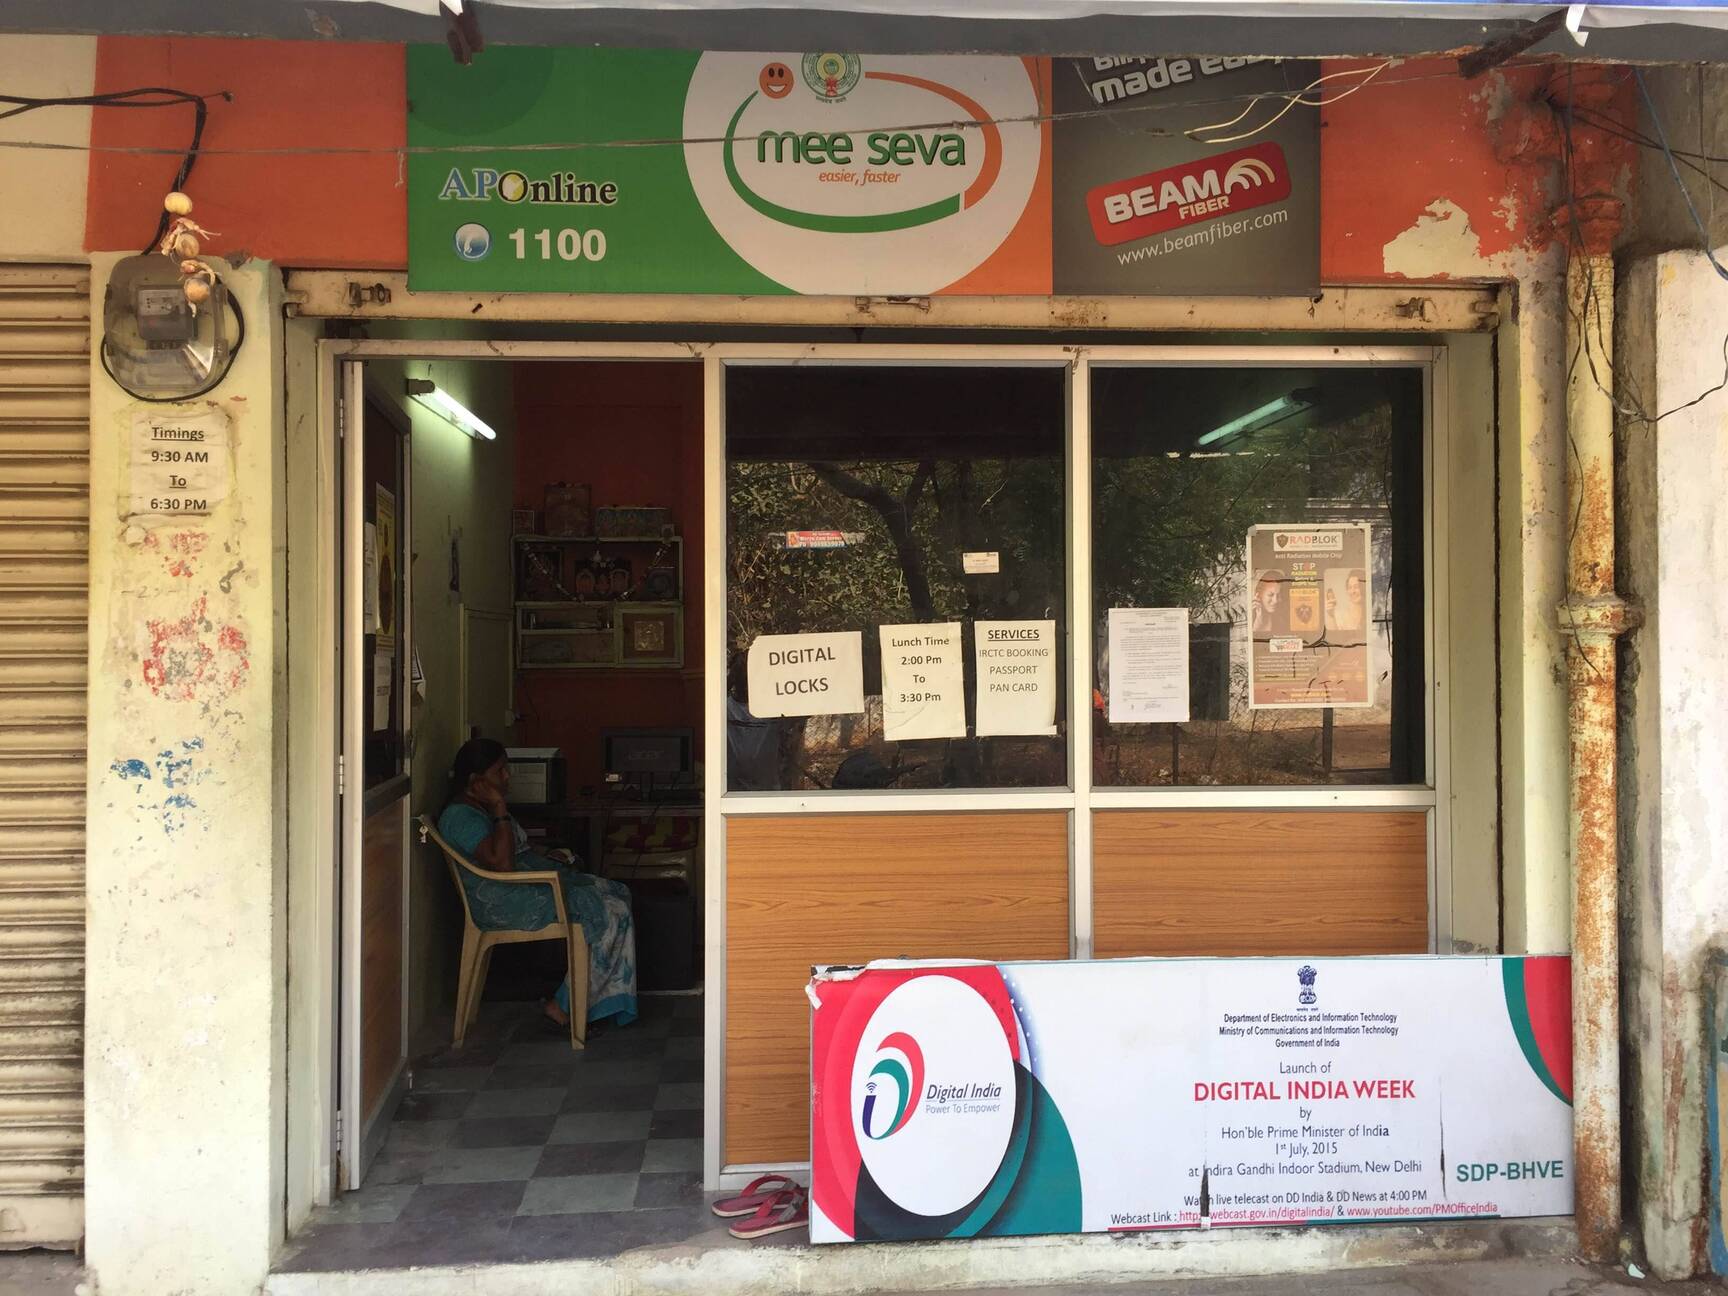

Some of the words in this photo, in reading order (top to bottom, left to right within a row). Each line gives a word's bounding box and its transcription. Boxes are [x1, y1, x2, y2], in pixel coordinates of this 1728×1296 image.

[1092, 57, 1193, 103] made
[757, 130, 853, 164] mee
[867, 132, 966, 166] seva
[819, 169, 860, 185] easier,
[860, 168, 901, 186] faster
[1103, 168, 1221, 224] BEAM
[1178, 195, 1230, 220] FIBER
[1117, 209, 1289, 265] www.beamfiber.com
[508, 228, 607, 261] 1100
[151, 427, 205, 441] Timings
[151, 450, 181, 462] 9:30
[184, 451, 209, 463] AM
[169, 475, 187, 488] To
[150, 498, 180, 510] 6:30
[184, 499, 207, 510] PM
[1289, 535, 1338, 544] RADBLOK
[892, 637, 922, 647] Lunch
[924, 636, 950, 646] Time
[988, 629, 1040, 641] SERVICES
[768, 646, 836, 666] DIGITAL
[979, 649, 1005, 657] IRCTC
[1006, 648, 1049, 657] BOOKING
[901, 656, 923, 665] 2:00
[926, 656, 942, 664] Pm
[989, 665, 1038, 675] PASSPORT
[913, 674, 926, 683] To
[775, 677, 829, 695] LOCKS
[990, 684, 1010, 692] PAN
[1012, 683, 1038, 692] CARD
[900, 693, 922, 702] 3:30
[925, 692, 941, 701] Pm
[1224, 1014, 1262, 1023] Department
[1263, 1014, 1270, 1022] of
[1271, 1013, 1307, 1022] Electronics
[1308, 1013, 1320, 1022] and
[1322, 1013, 1359, 1022] Information
[1360, 1013, 1398, 1023] Technology
[1219, 1026, 1245, 1036] Ministry
[1247, 1026, 1254, 1035] of
[1255, 1026, 1309, 1035] Communications
[1310, 1026, 1322, 1035] and
[1324, 1025, 1360, 1034] Information
[1362, 1025, 1399, 1036] Technology
[1275, 1039, 1315, 1048] Government
[1316, 1039, 1323, 1047] of
[1324, 1039, 1340, 1047] India
[1280, 1062, 1316, 1074] Launch
[1321, 1061, 1332, 1073] of
[926, 1083, 968, 1104] Digital
[970, 1082, 1001, 1098] India
[1194, 1081, 1281, 1101] DIGITAL
[1288, 1080, 1349, 1100] INDIA
[1353, 1079, 1416, 1099] WEEK
[926, 1104, 950, 1114] Power
[953, 1104, 962, 1113] To
[964, 1103, 1001, 1114] Empower
[1300, 1106, 1312, 1121] by
[1222, 1126, 1264, 1139] Hon'ble
[1267, 1125, 1299, 1138] Prime
[1302, 1125, 1345, 1138] Minister
[1349, 1124, 1360, 1137] of
[1362, 1124, 1390, 1137] India
[1275, 1143, 1287, 1155] 1st
[1289, 1142, 1310, 1158] July,
[1312, 1142, 1338, 1155] 2015
[1188, 1166, 1199, 1177] at
[1236, 1162, 1275, 1175] Gandhi
[1278, 1161, 1315, 1175] Indoor
[1318, 1160, 1363, 1174] Stadium,
[1365, 1161, 1390, 1173] New
[1394, 1159, 1422, 1172] Delhi
[1456, 1160, 1564, 1182] SDP-BHVE
[1216, 1193, 1232, 1205] live
[1234, 1193, 1269, 1204] telecast
[1272, 1194, 1283, 1203] on
[1286, 1192, 1300, 1203] DD
[1302, 1191, 1325, 1203] India
[1327, 1192, 1334, 1202] &
[1336, 1191, 1351, 1201] DD
[1353, 1190, 1377, 1201] News
[1379, 1191, 1388, 1201] at
[1390, 1190, 1410, 1201] 4:00
[1412, 1190, 1427, 1200] PM
[1111, 1213, 1150, 1225] Webcast
[1153, 1212, 1172, 1223] Link
[1337, 1206, 1344, 1216] &
[1347, 1203, 1498, 1217] www.youtube.com/PMOfficeIndia
